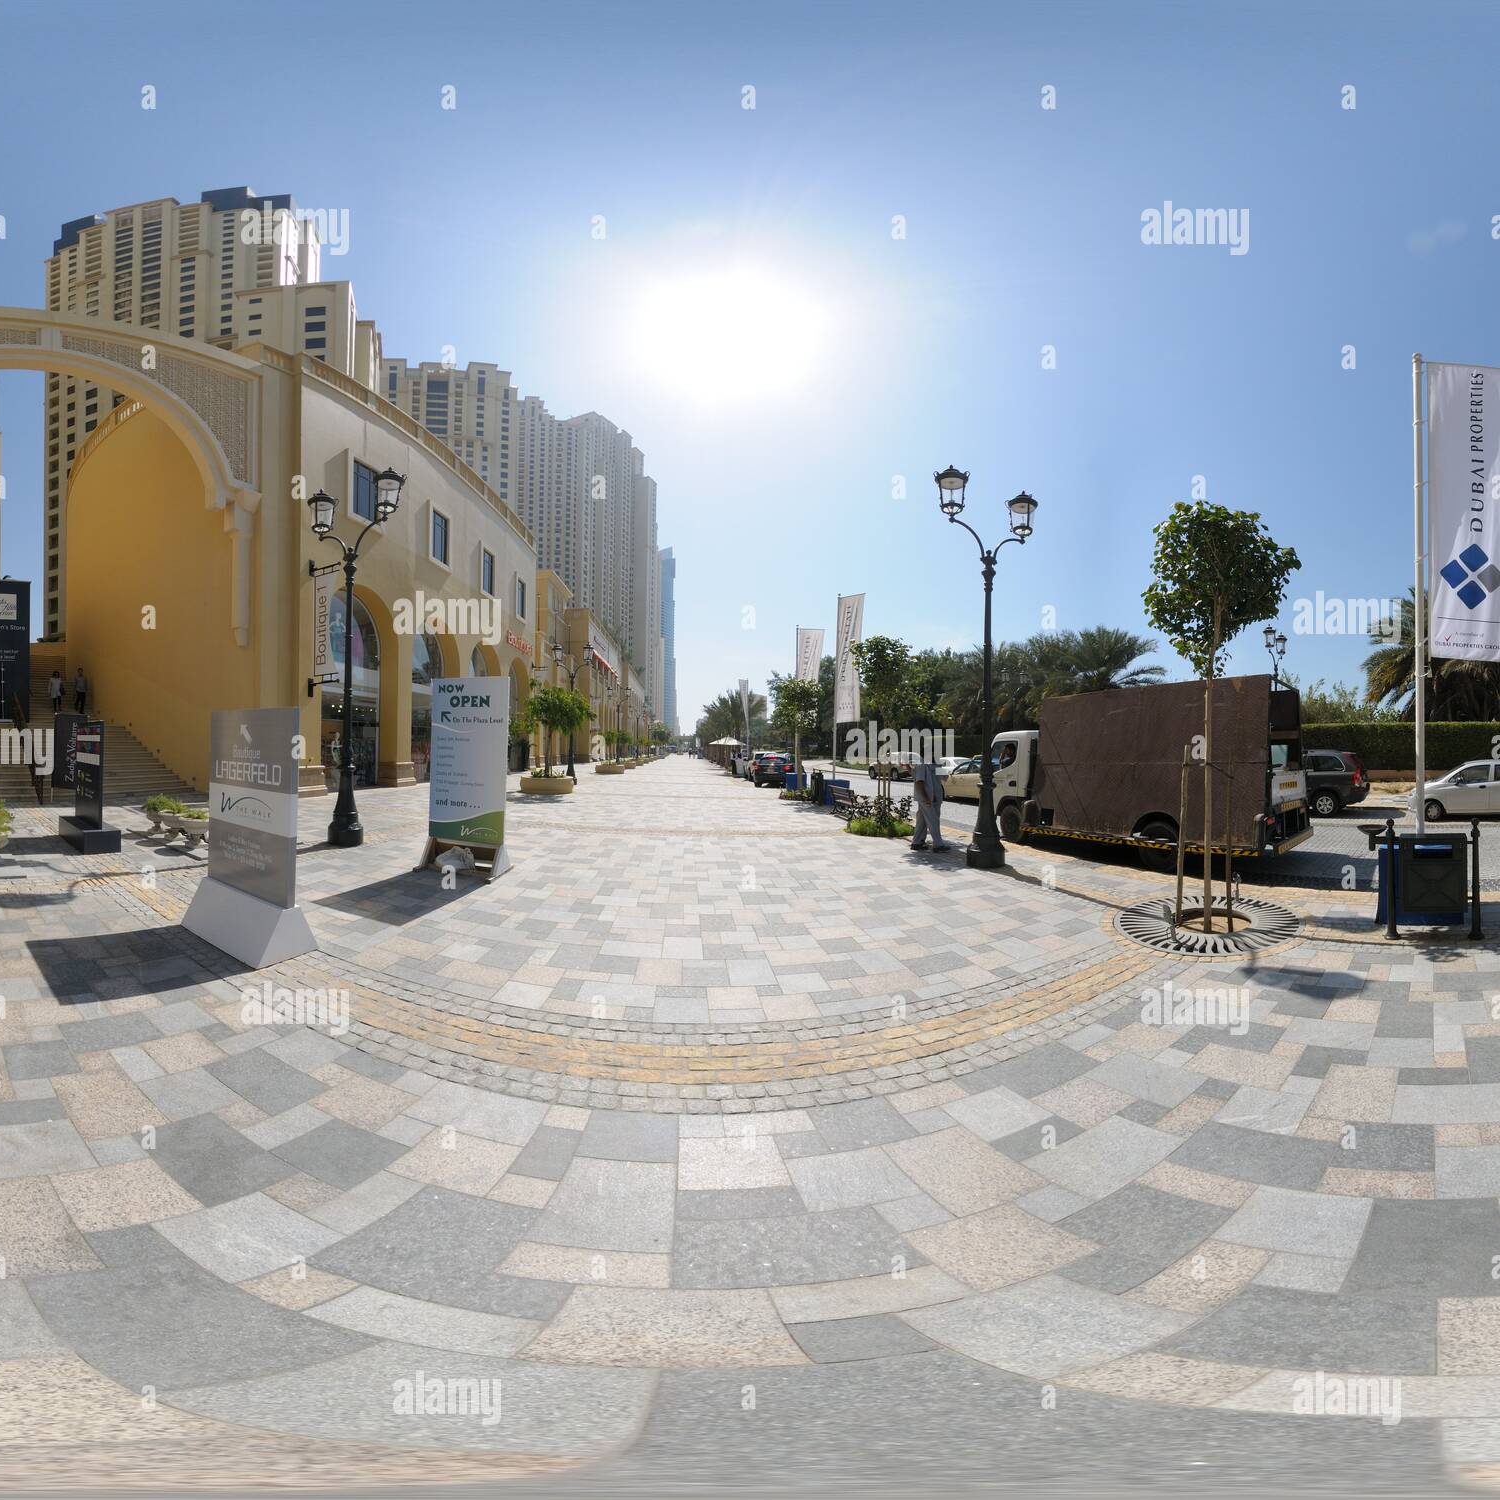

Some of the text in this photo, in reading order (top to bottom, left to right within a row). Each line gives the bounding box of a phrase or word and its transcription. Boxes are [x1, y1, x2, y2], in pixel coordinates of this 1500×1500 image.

[1470, 372, 1485, 533] DUBAI PROPERTIES
[316, 595, 329, 666] Boutique
[438, 684, 465, 694] NOW
[450, 695, 491, 708] OPEN
[215, 759, 282, 786] LAGERFELD
[435, 798, 449, 807] and
[450, 798, 468, 809] more
